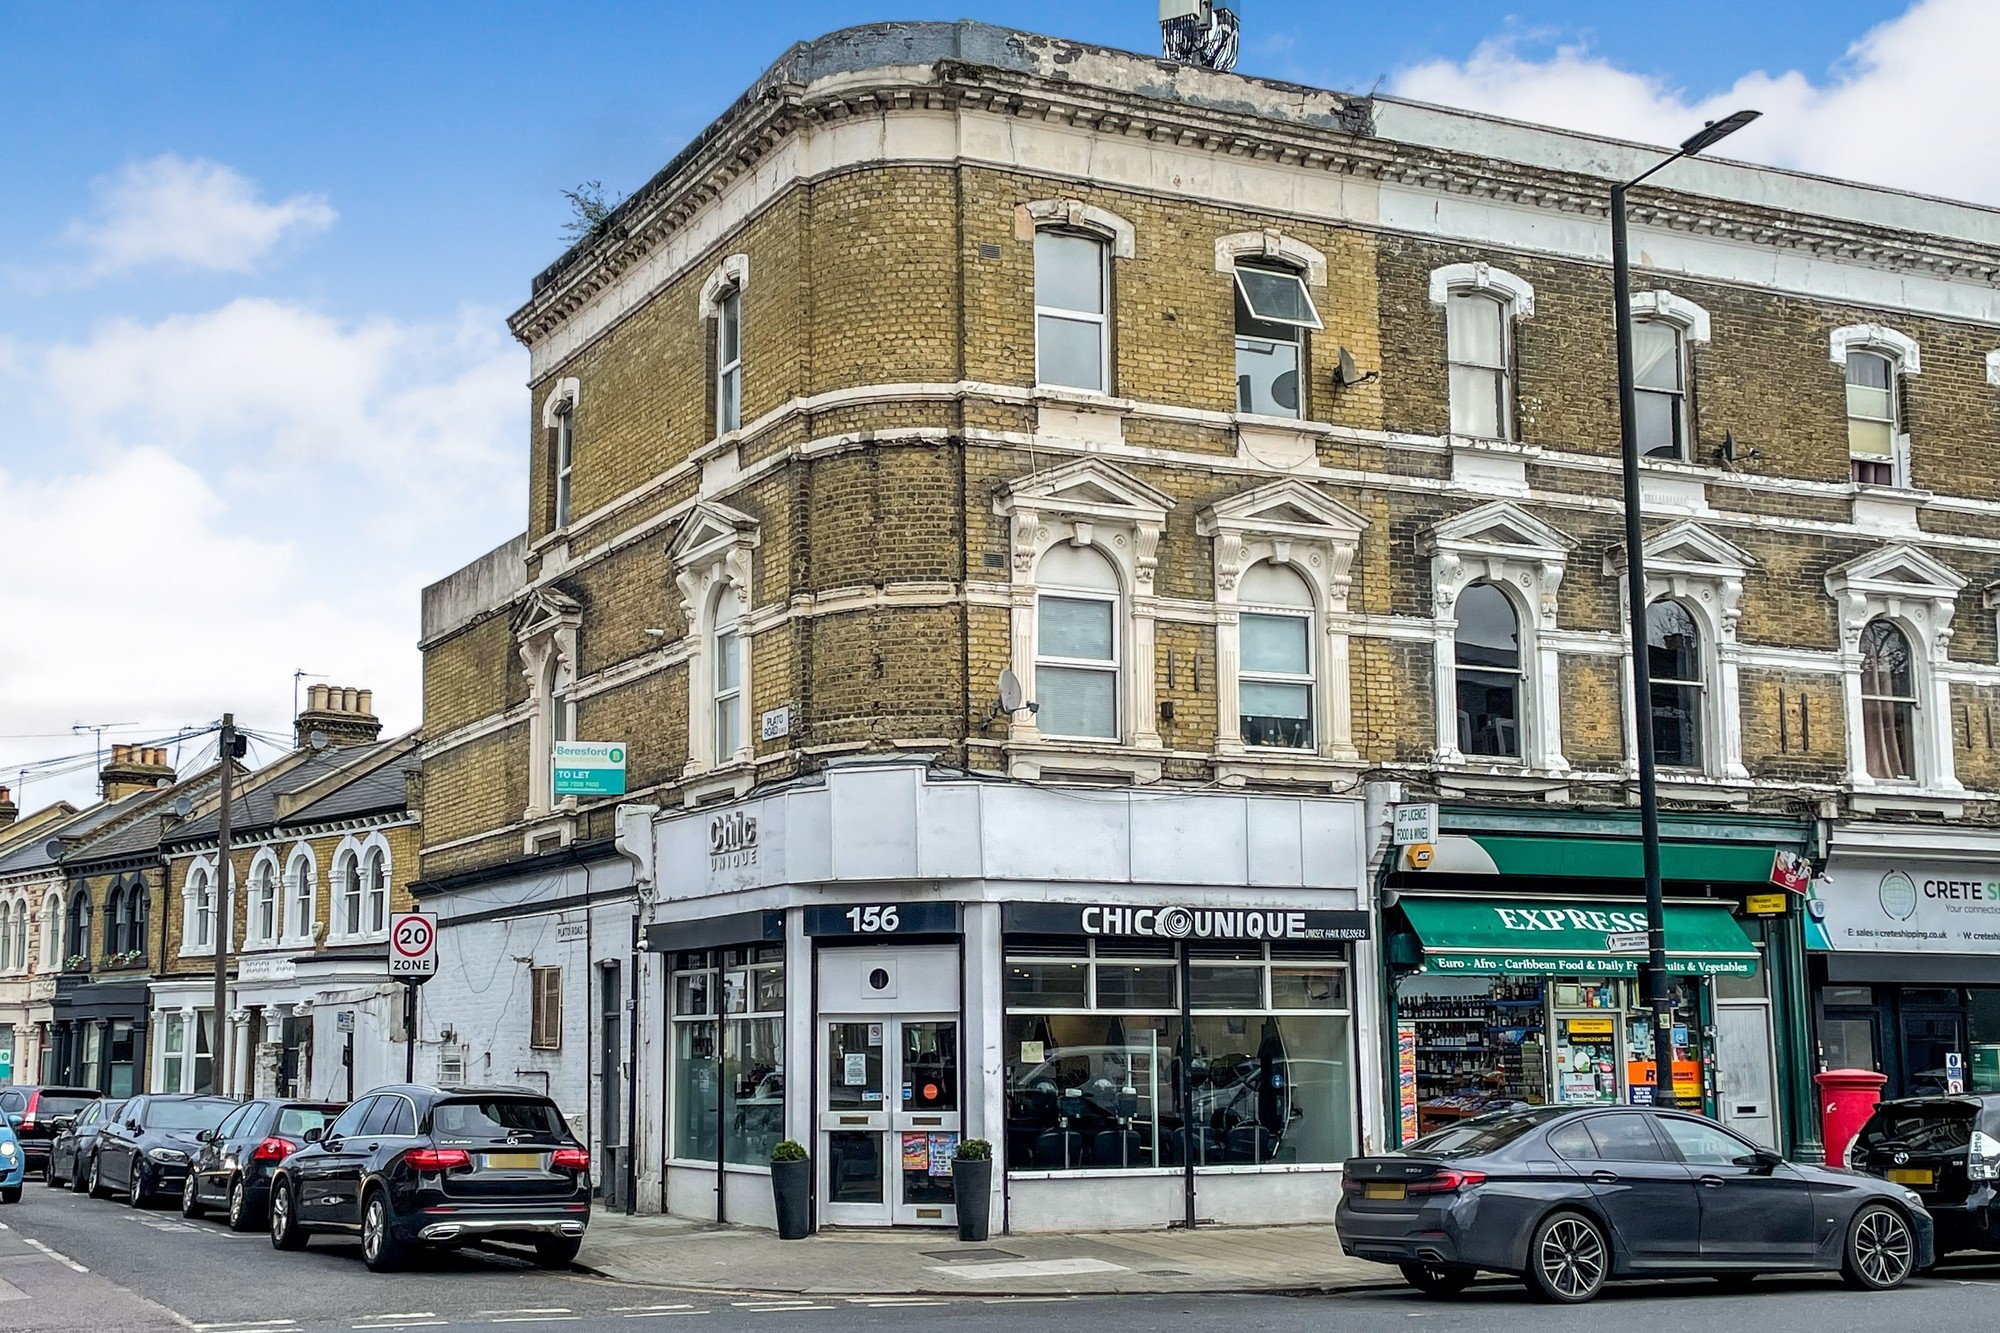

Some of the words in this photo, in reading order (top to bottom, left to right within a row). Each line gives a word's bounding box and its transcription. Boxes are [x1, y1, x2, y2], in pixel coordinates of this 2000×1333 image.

[767, 714, 783, 727] PLATO
[764, 726, 778, 737] ROAD
[557, 747, 608, 756] Beresford
[573, 771, 590, 779] LET
[1399, 810, 1407, 822] OFF
[1408, 808, 1427, 821] LICENCE
[711, 811, 757, 849] Chic
[1397, 828, 1409, 841] FOOD
[711, 850, 757, 872] UNIQUE
[1924, 881, 1982, 900] CRETE
[1945, 904, 1962, 913] Your
[846, 905, 900, 932] 156
[1082, 907, 1154, 936] CHIC
[1195, 911, 1306, 939] UNIQUE
[1494, 908, 1649, 932] EXPRESS
[400, 928, 427, 944] 20
[394, 960, 430, 970] ZONE
[1438, 958, 1464, 968] Euro
[1474, 959, 1496, 968] Afro
[1505, 959, 1556, 969] Caribbean
[1559, 960, 1584, 970] Food
[1586, 961, 1595, 970] &
[1598, 960, 1623, 972] Daily
[1688, 962, 1696, 971] &
[1700, 962, 1747, 972] Vegetables
